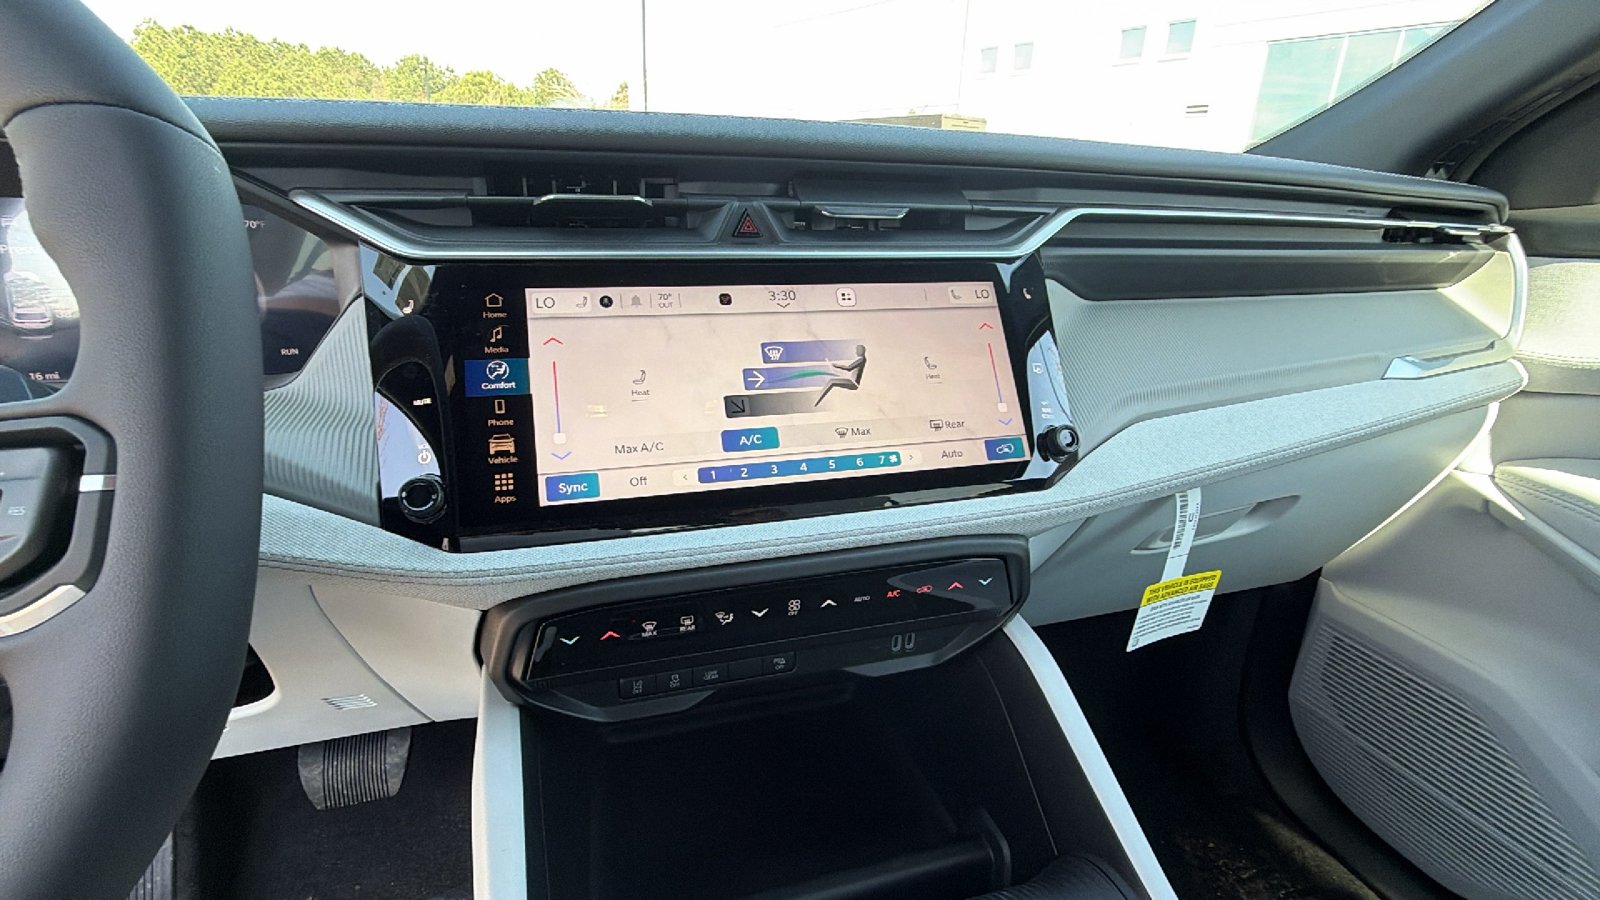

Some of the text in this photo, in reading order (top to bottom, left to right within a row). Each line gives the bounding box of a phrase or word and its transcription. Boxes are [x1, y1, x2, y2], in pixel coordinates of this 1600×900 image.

[658, 293, 672, 301] 70°
[768, 290, 797, 301] 3:30
[975, 289, 990, 299] LO
[536, 296, 556, 309] LO
[482, 311, 508, 319] Home
[280, 348, 299, 356] RUN
[484, 346, 510, 354] Media
[45, 371, 61, 380] mi
[481, 381, 517, 390] Comfort
[487, 419, 514, 427] Phone
[944, 420, 966, 429] Rear
[850, 427, 871, 437] Max
[739, 434, 763, 446] A/C
[614, 441, 665, 455] Max A/C
[941, 449, 964, 459] Auto
[487, 455, 519, 465] Vehicle
[710, 455, 886, 480] 1 2 3 4 5 6 7
[628, 476, 648, 487] Off
[558, 482, 589, 496] Sync
[493, 495, 517, 504] Apps
[886, 590, 900, 598] A/C
[642, 630, 657, 638] MAX
